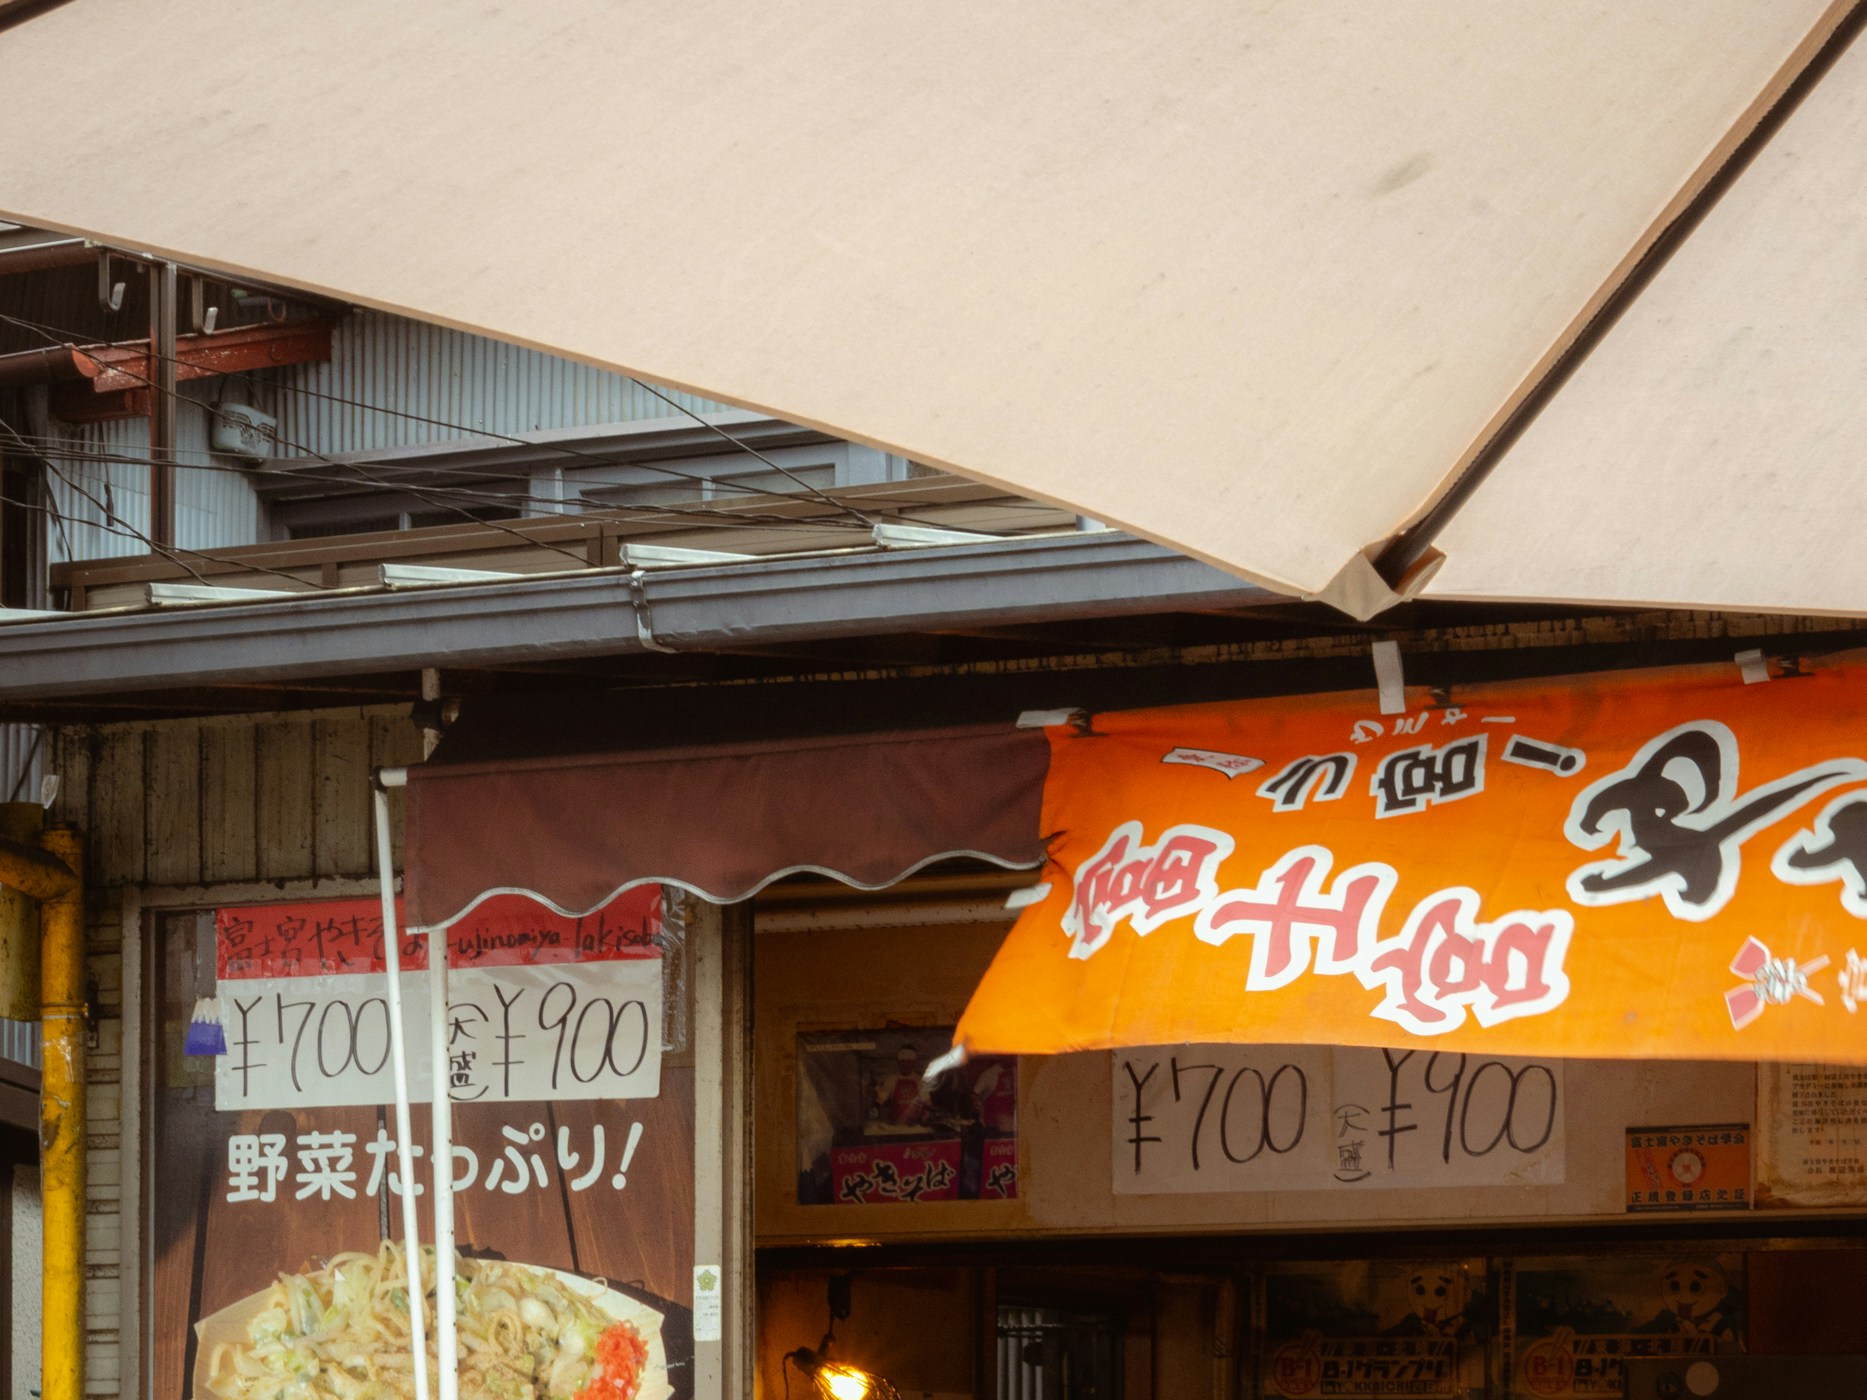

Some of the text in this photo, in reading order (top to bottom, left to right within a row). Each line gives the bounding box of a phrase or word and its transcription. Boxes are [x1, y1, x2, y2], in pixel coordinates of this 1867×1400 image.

[1062, 821, 1574, 1035] 富士宮
[232, 991, 391, 1098] ¥700
[493, 981, 648, 1097] ¥900
[1124, 1056, 1307, 1175] ¥700
